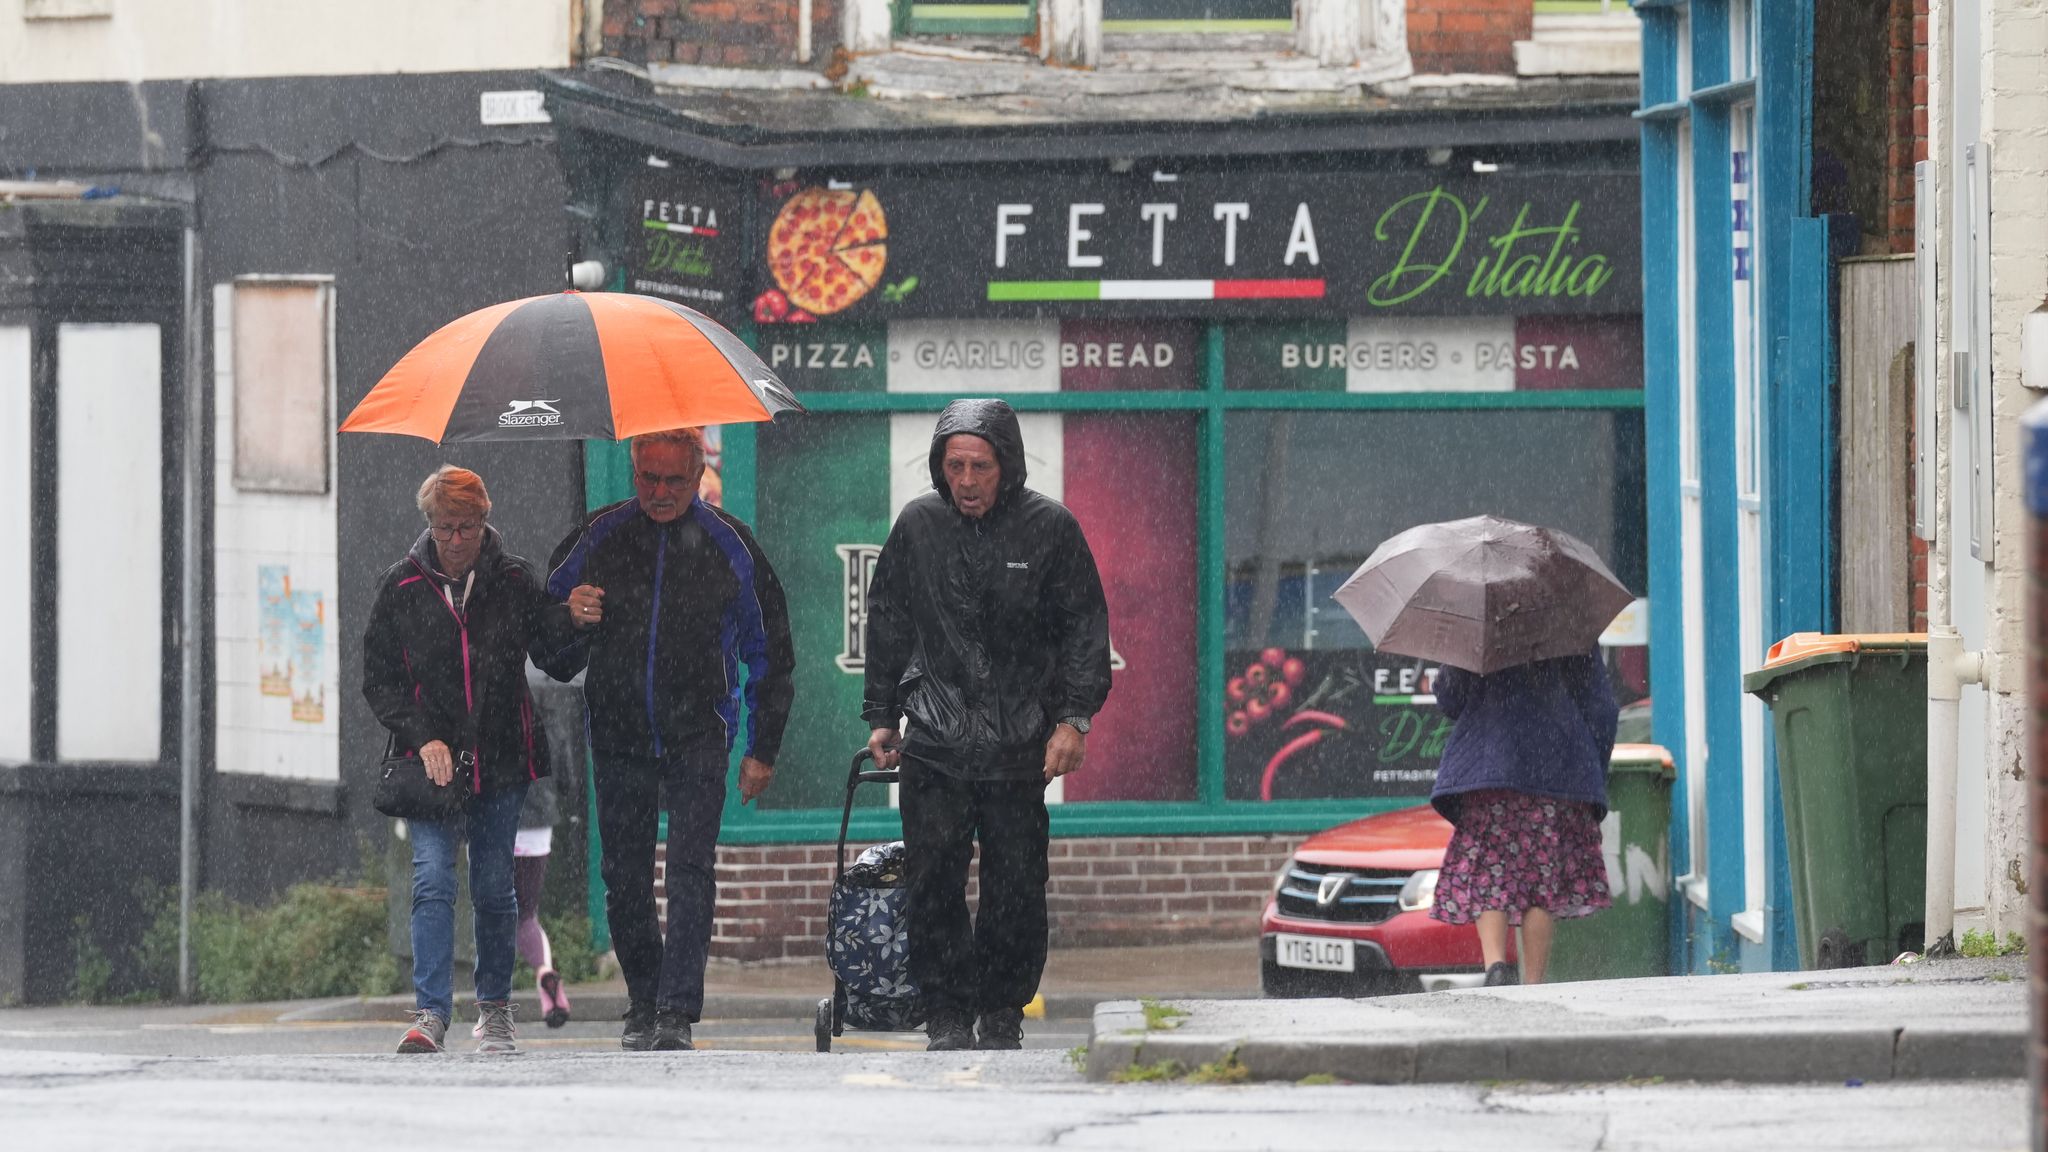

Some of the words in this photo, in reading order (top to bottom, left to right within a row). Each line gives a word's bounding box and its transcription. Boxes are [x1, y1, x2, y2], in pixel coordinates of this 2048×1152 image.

[486, 96, 519, 119] BROOK
[643, 199, 718, 228] FETTA
[995, 203, 1321, 268] FETTA
[1367, 185, 1617, 307] D'italia
[771, 343, 874, 369] PIZZA
[915, 341, 1046, 369] GARLIC
[1060, 342, 1175, 368] BREAD
[1281, 343, 1439, 370] BURGERS
[1475, 343, 1581, 370] PASTA
[498, 414, 561, 427] Slazenger
[1284, 940, 1313, 963] YT15
